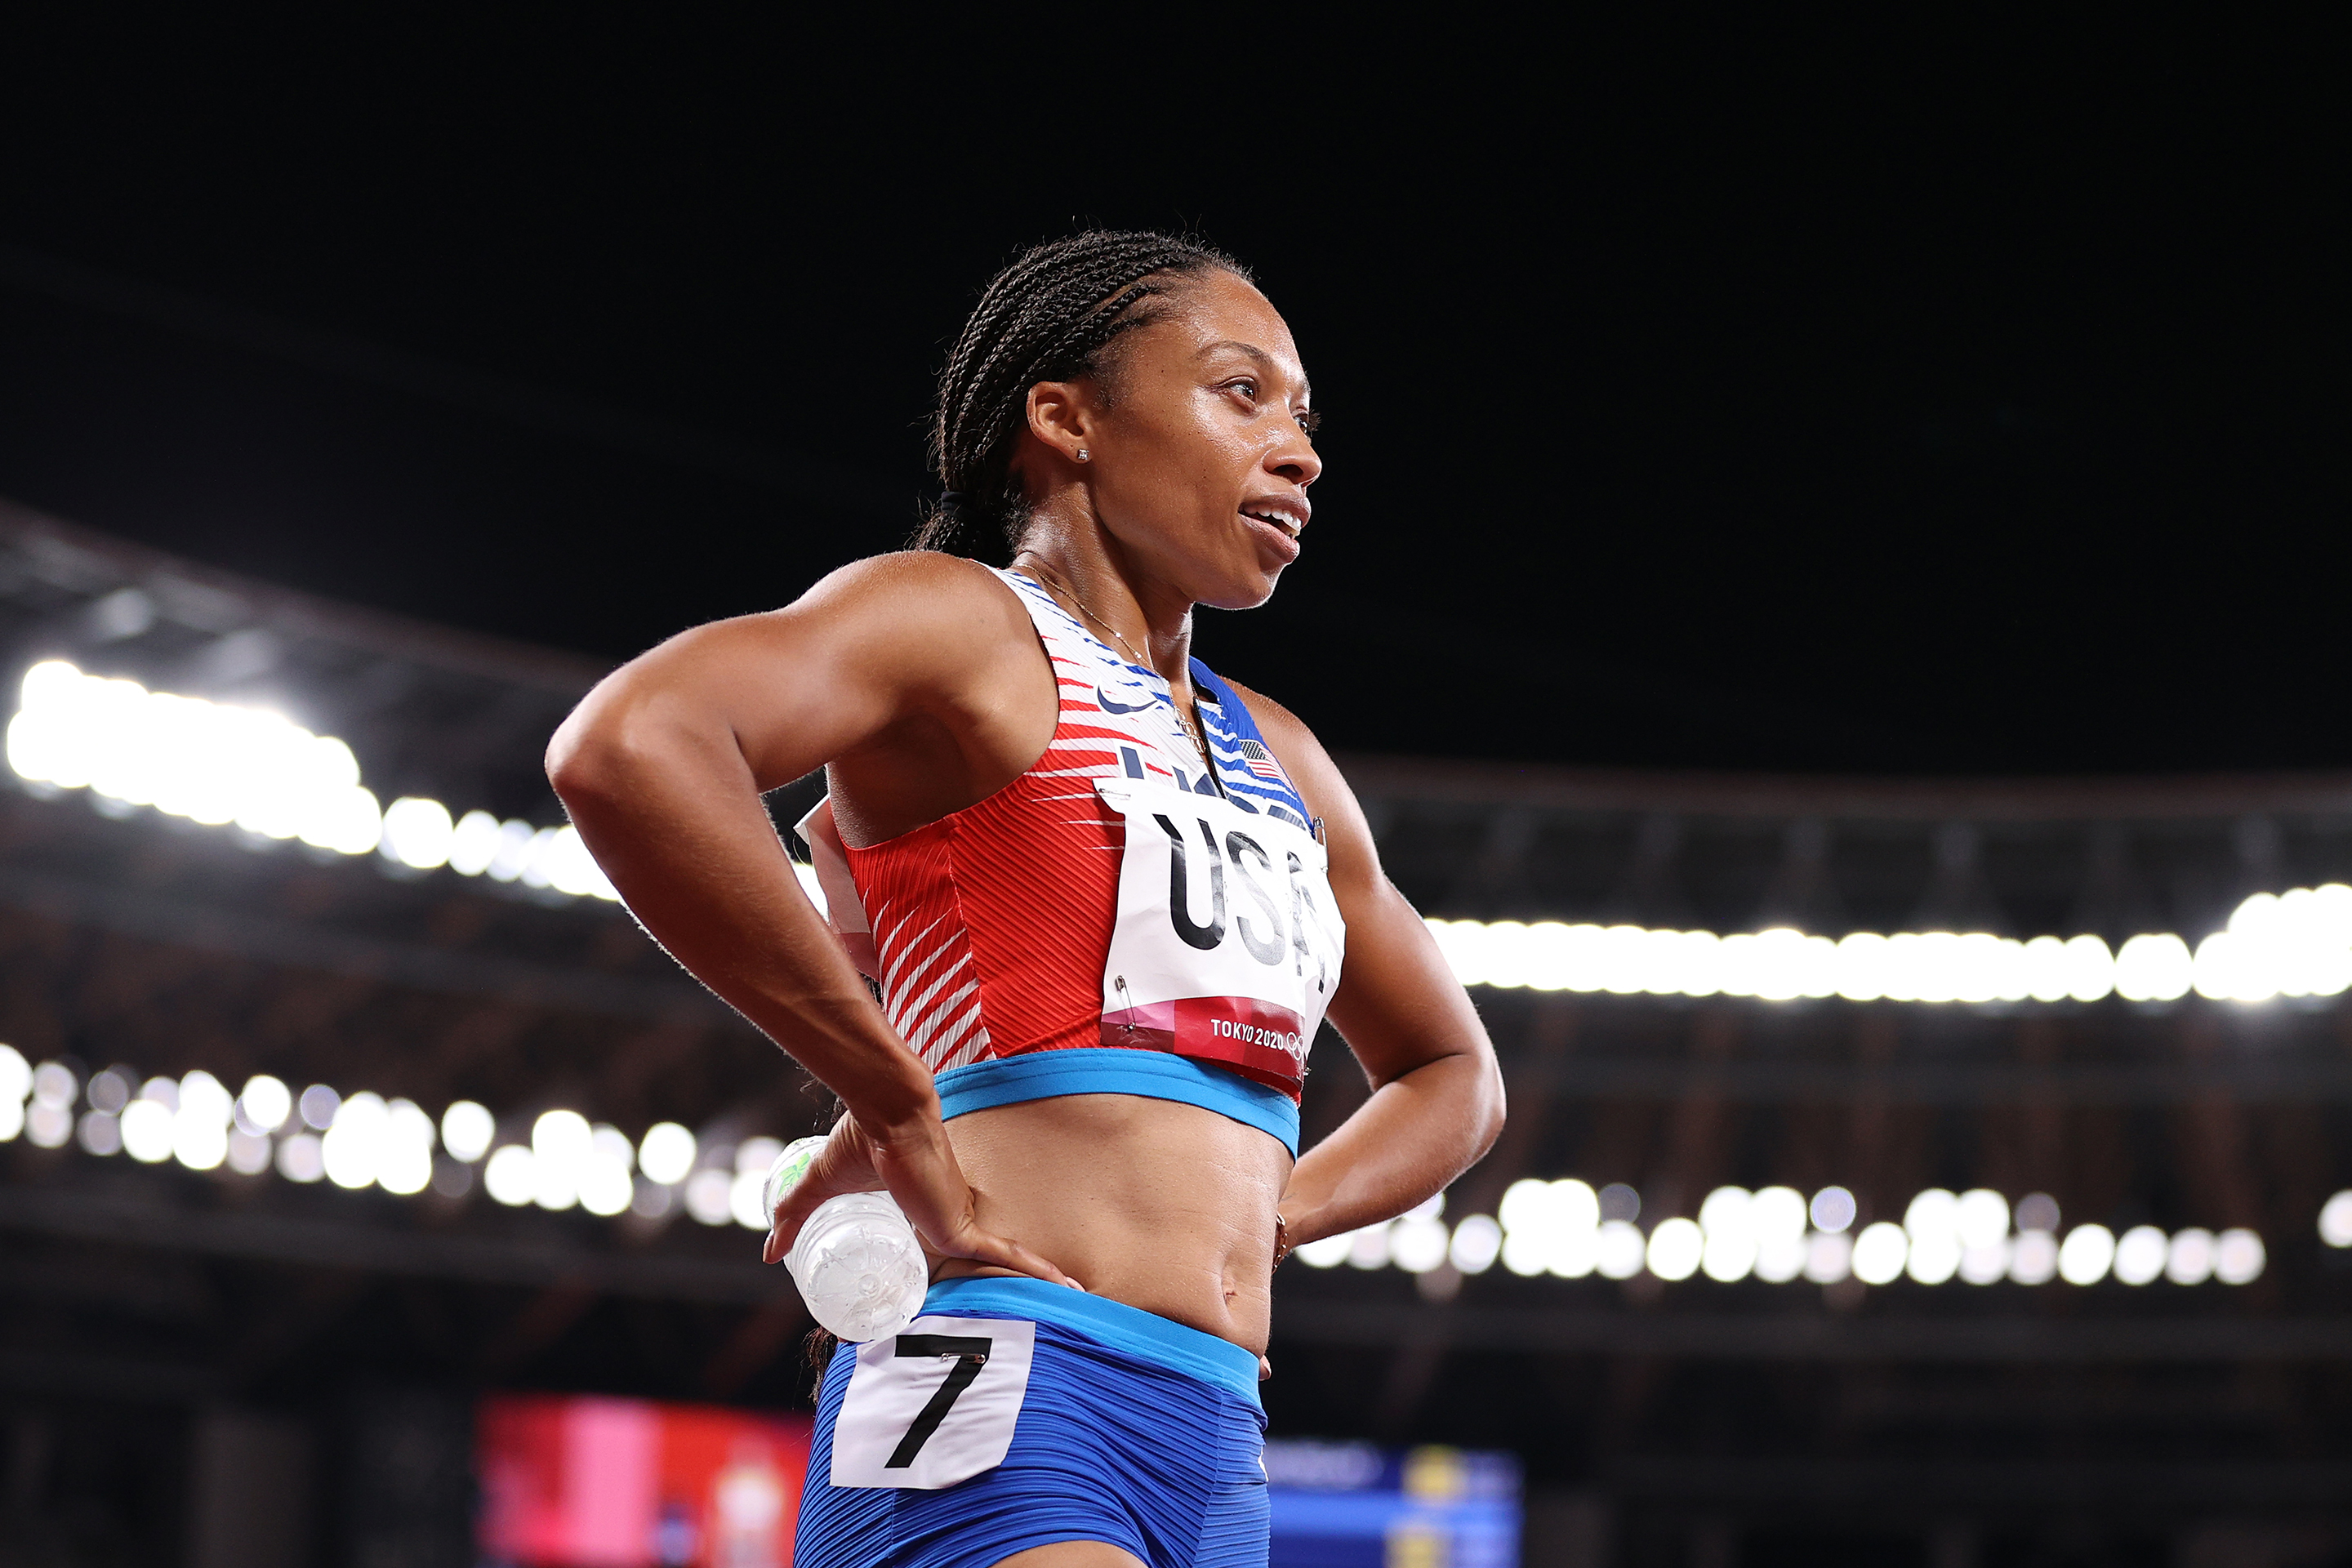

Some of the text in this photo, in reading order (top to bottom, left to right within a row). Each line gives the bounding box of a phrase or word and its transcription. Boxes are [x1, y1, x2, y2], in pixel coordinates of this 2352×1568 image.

[1152, 813, 1325, 994] USA
[1210, 1018, 1284, 1050] TOKYO 2020
[884, 1334, 992, 1468] 7
